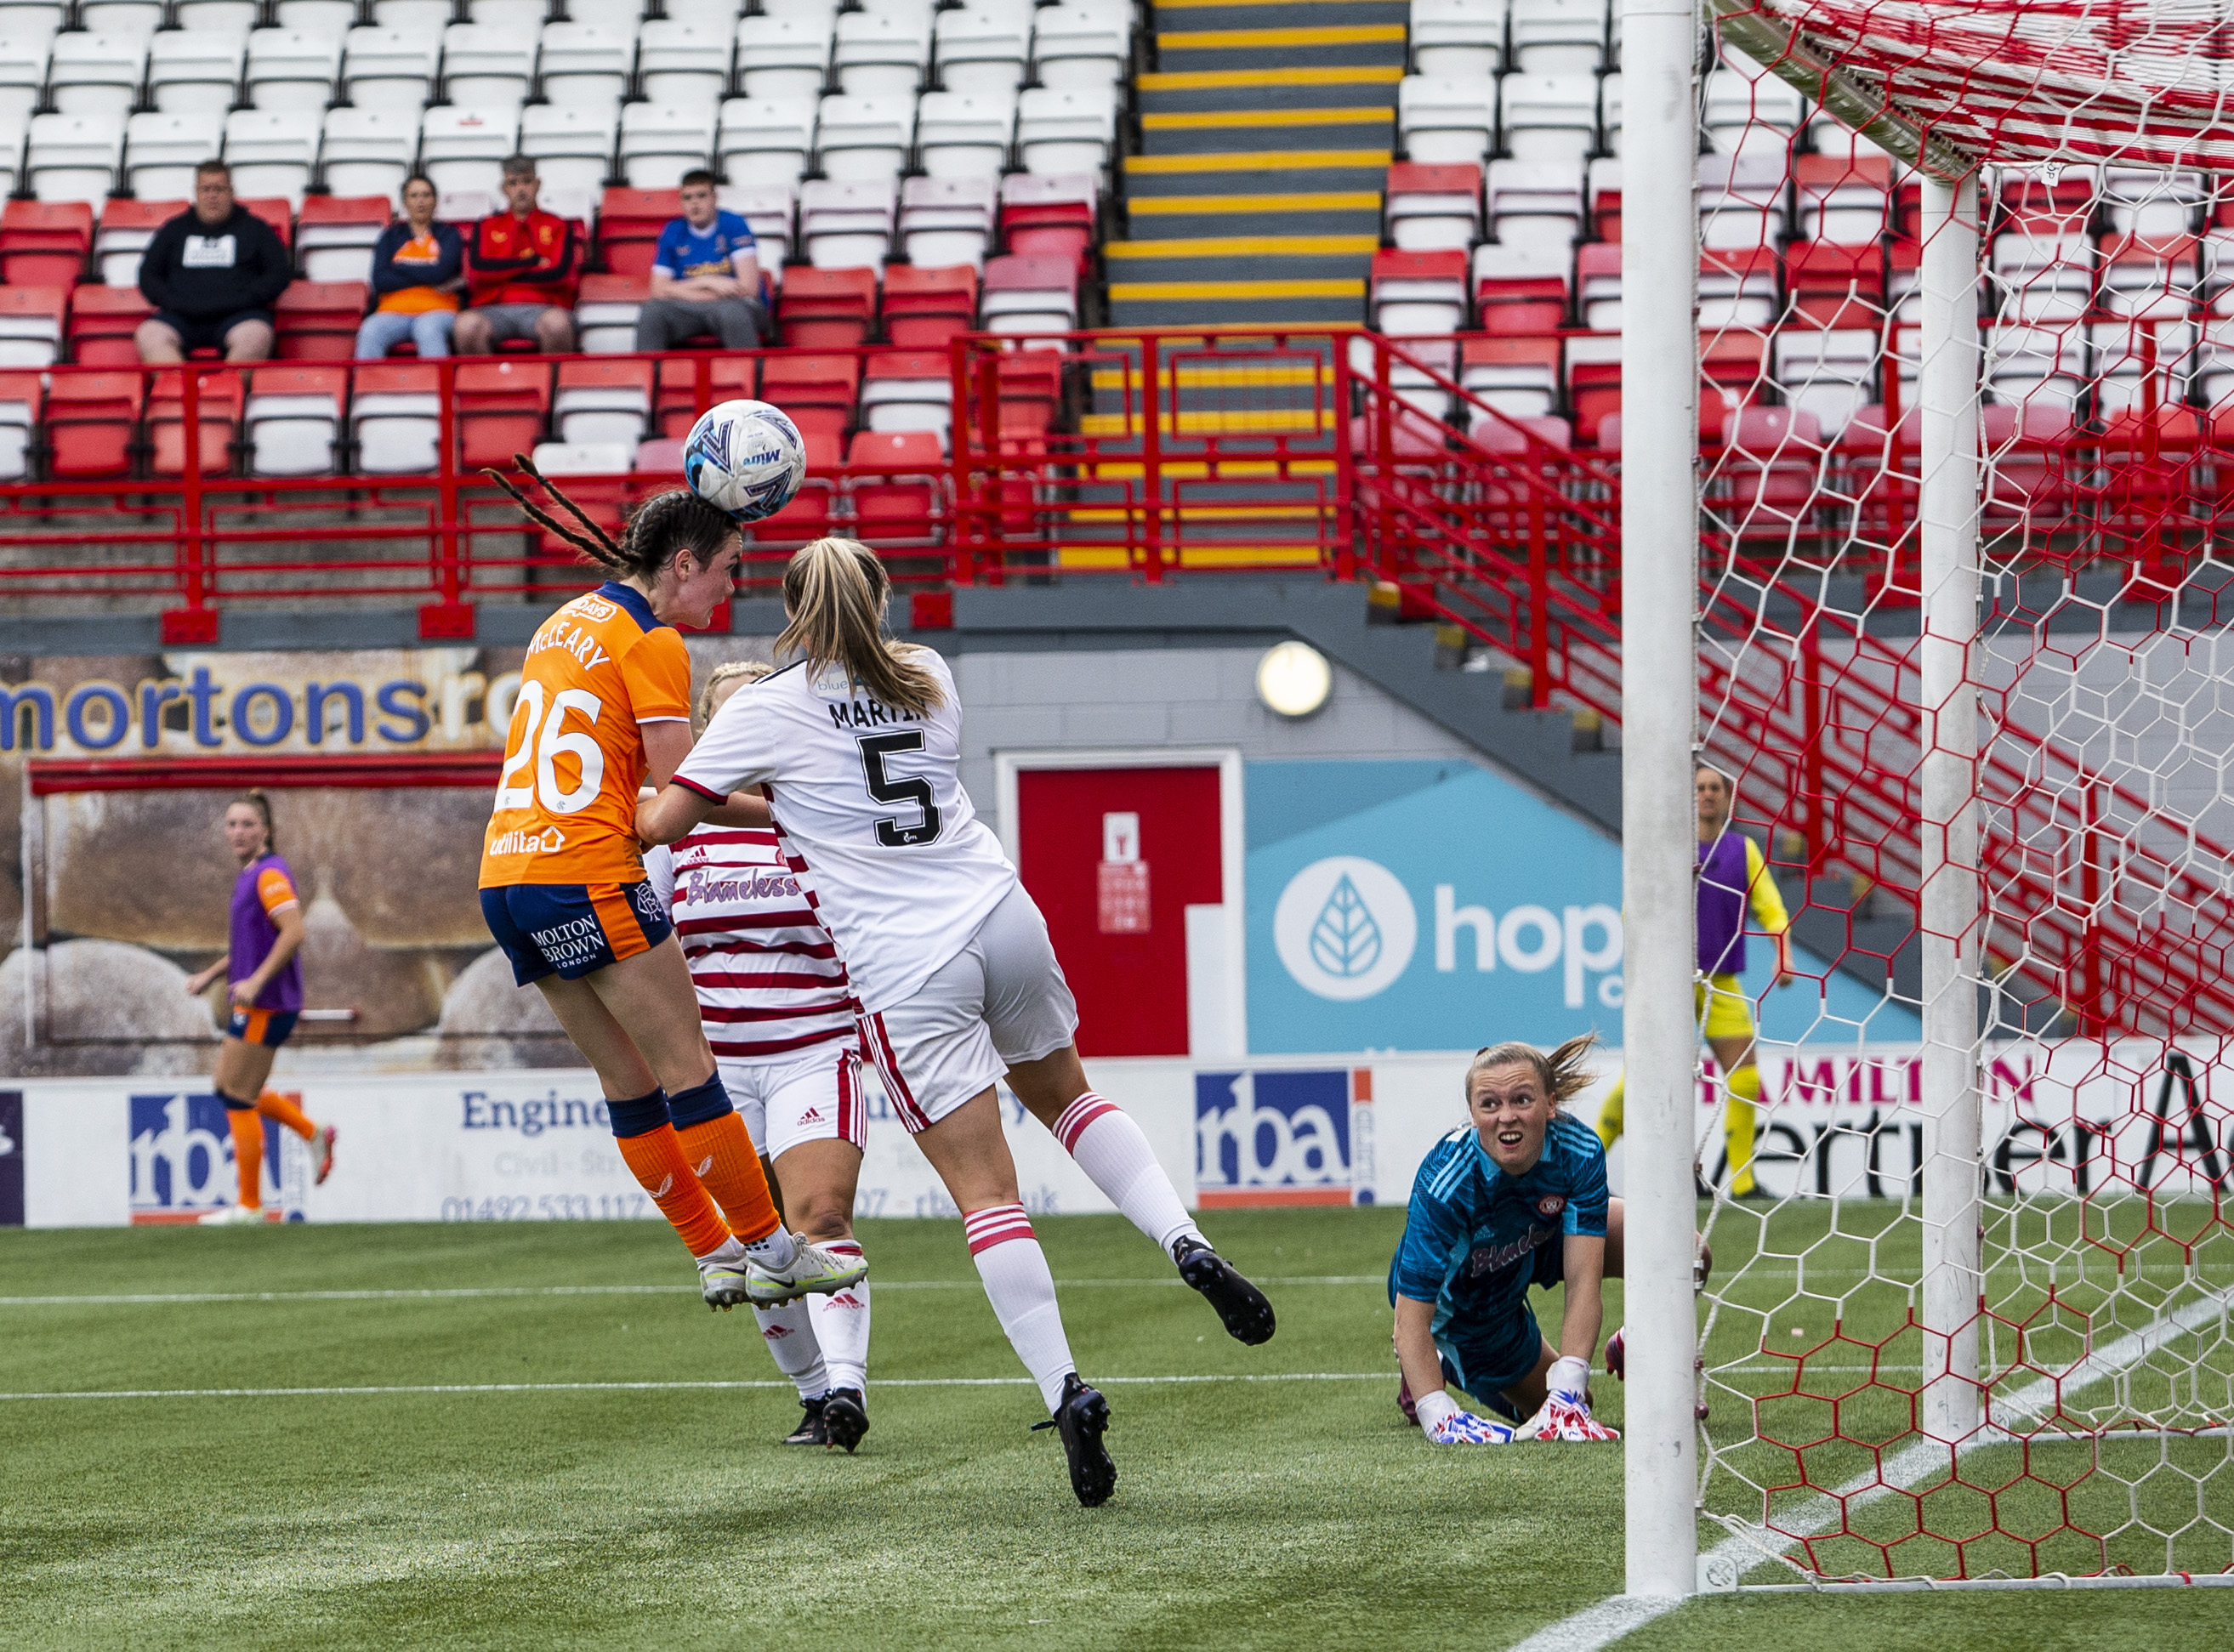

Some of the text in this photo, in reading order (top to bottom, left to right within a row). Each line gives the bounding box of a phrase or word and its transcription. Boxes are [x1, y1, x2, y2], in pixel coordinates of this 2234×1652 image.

[493, 679, 605, 814] 26
[855, 728, 944, 848] 5
[489, 830, 540, 856] utilita
[685, 867, 799, 906] Blameless
[531, 914, 597, 947] MOLTON
[541, 931, 605, 962] BROWN
[556, 952, 597, 969] LONDON
[1695, 1056, 2033, 1105] MILTN
[797, 1117, 826, 1127] adidas
[1197, 1070, 1350, 1183] rba
[2135, 1053, 2234, 1195] A
